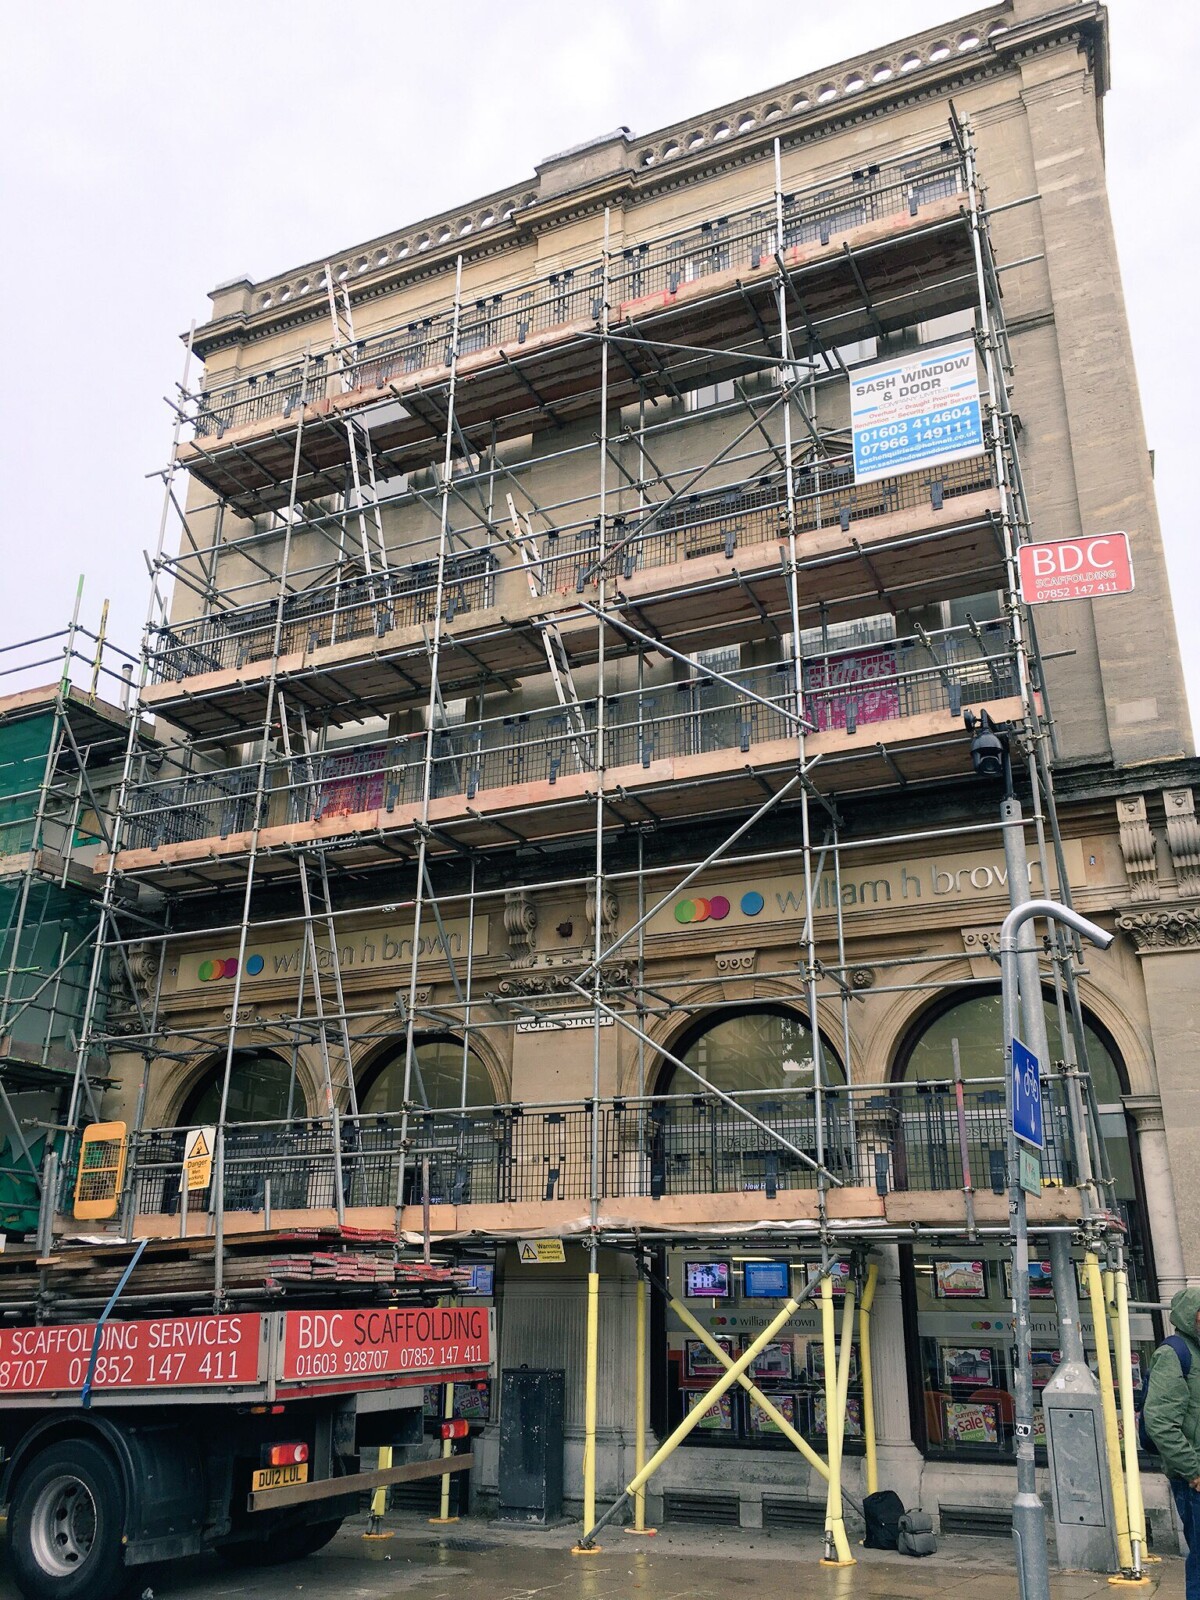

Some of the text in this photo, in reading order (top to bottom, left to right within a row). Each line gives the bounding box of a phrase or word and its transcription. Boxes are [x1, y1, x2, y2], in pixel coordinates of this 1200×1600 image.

[856, 356, 970, 397] SASH WINDOW
[883, 378, 941, 402] & DOOR
[854, 416, 889, 430] Renovation
[897, 408, 925, 420] Security
[932, 401, 948, 409] Free
[949, 394, 977, 405] Surveys
[868, 408, 897, 419] Overhaul
[905, 398, 930, 411] Draught
[932, 392, 960, 404] Proofing
[878, 386, 949, 410] COMPANY LIMITED
[860, 405, 971, 443] 01603 414604
[860, 420, 973, 457] 07966 149111
[859, 430, 977, 465] sashenquiries@hotmail.co.uk
[1032, 540, 1114, 576] BDC
[1035, 569, 1117, 588] SCAFFOLDING
[1037, 582, 1118, 600] 07852 147 411
[776, 878, 891, 913] wlliam
[902, 868, 921, 897] h
[361, 937, 375, 963] h
[187, 1160, 208, 1168] Danger
[11, 1318, 242, 1355] SCAFFOLDING SERVICES
[299, 1310, 482, 1349] BDC SCAFFOLDING
[69, 1356, 134, 1385] 07852
[146, 1353, 187, 1382] 147
[198, 1351, 239, 1379] 411
[296, 1345, 482, 1375] 01603 928707 07852 147 411
[460, 1396, 480, 1410] sale
[957, 1417, 983, 1432] sale
[259, 1466, 302, 1487] DU12 LUL
